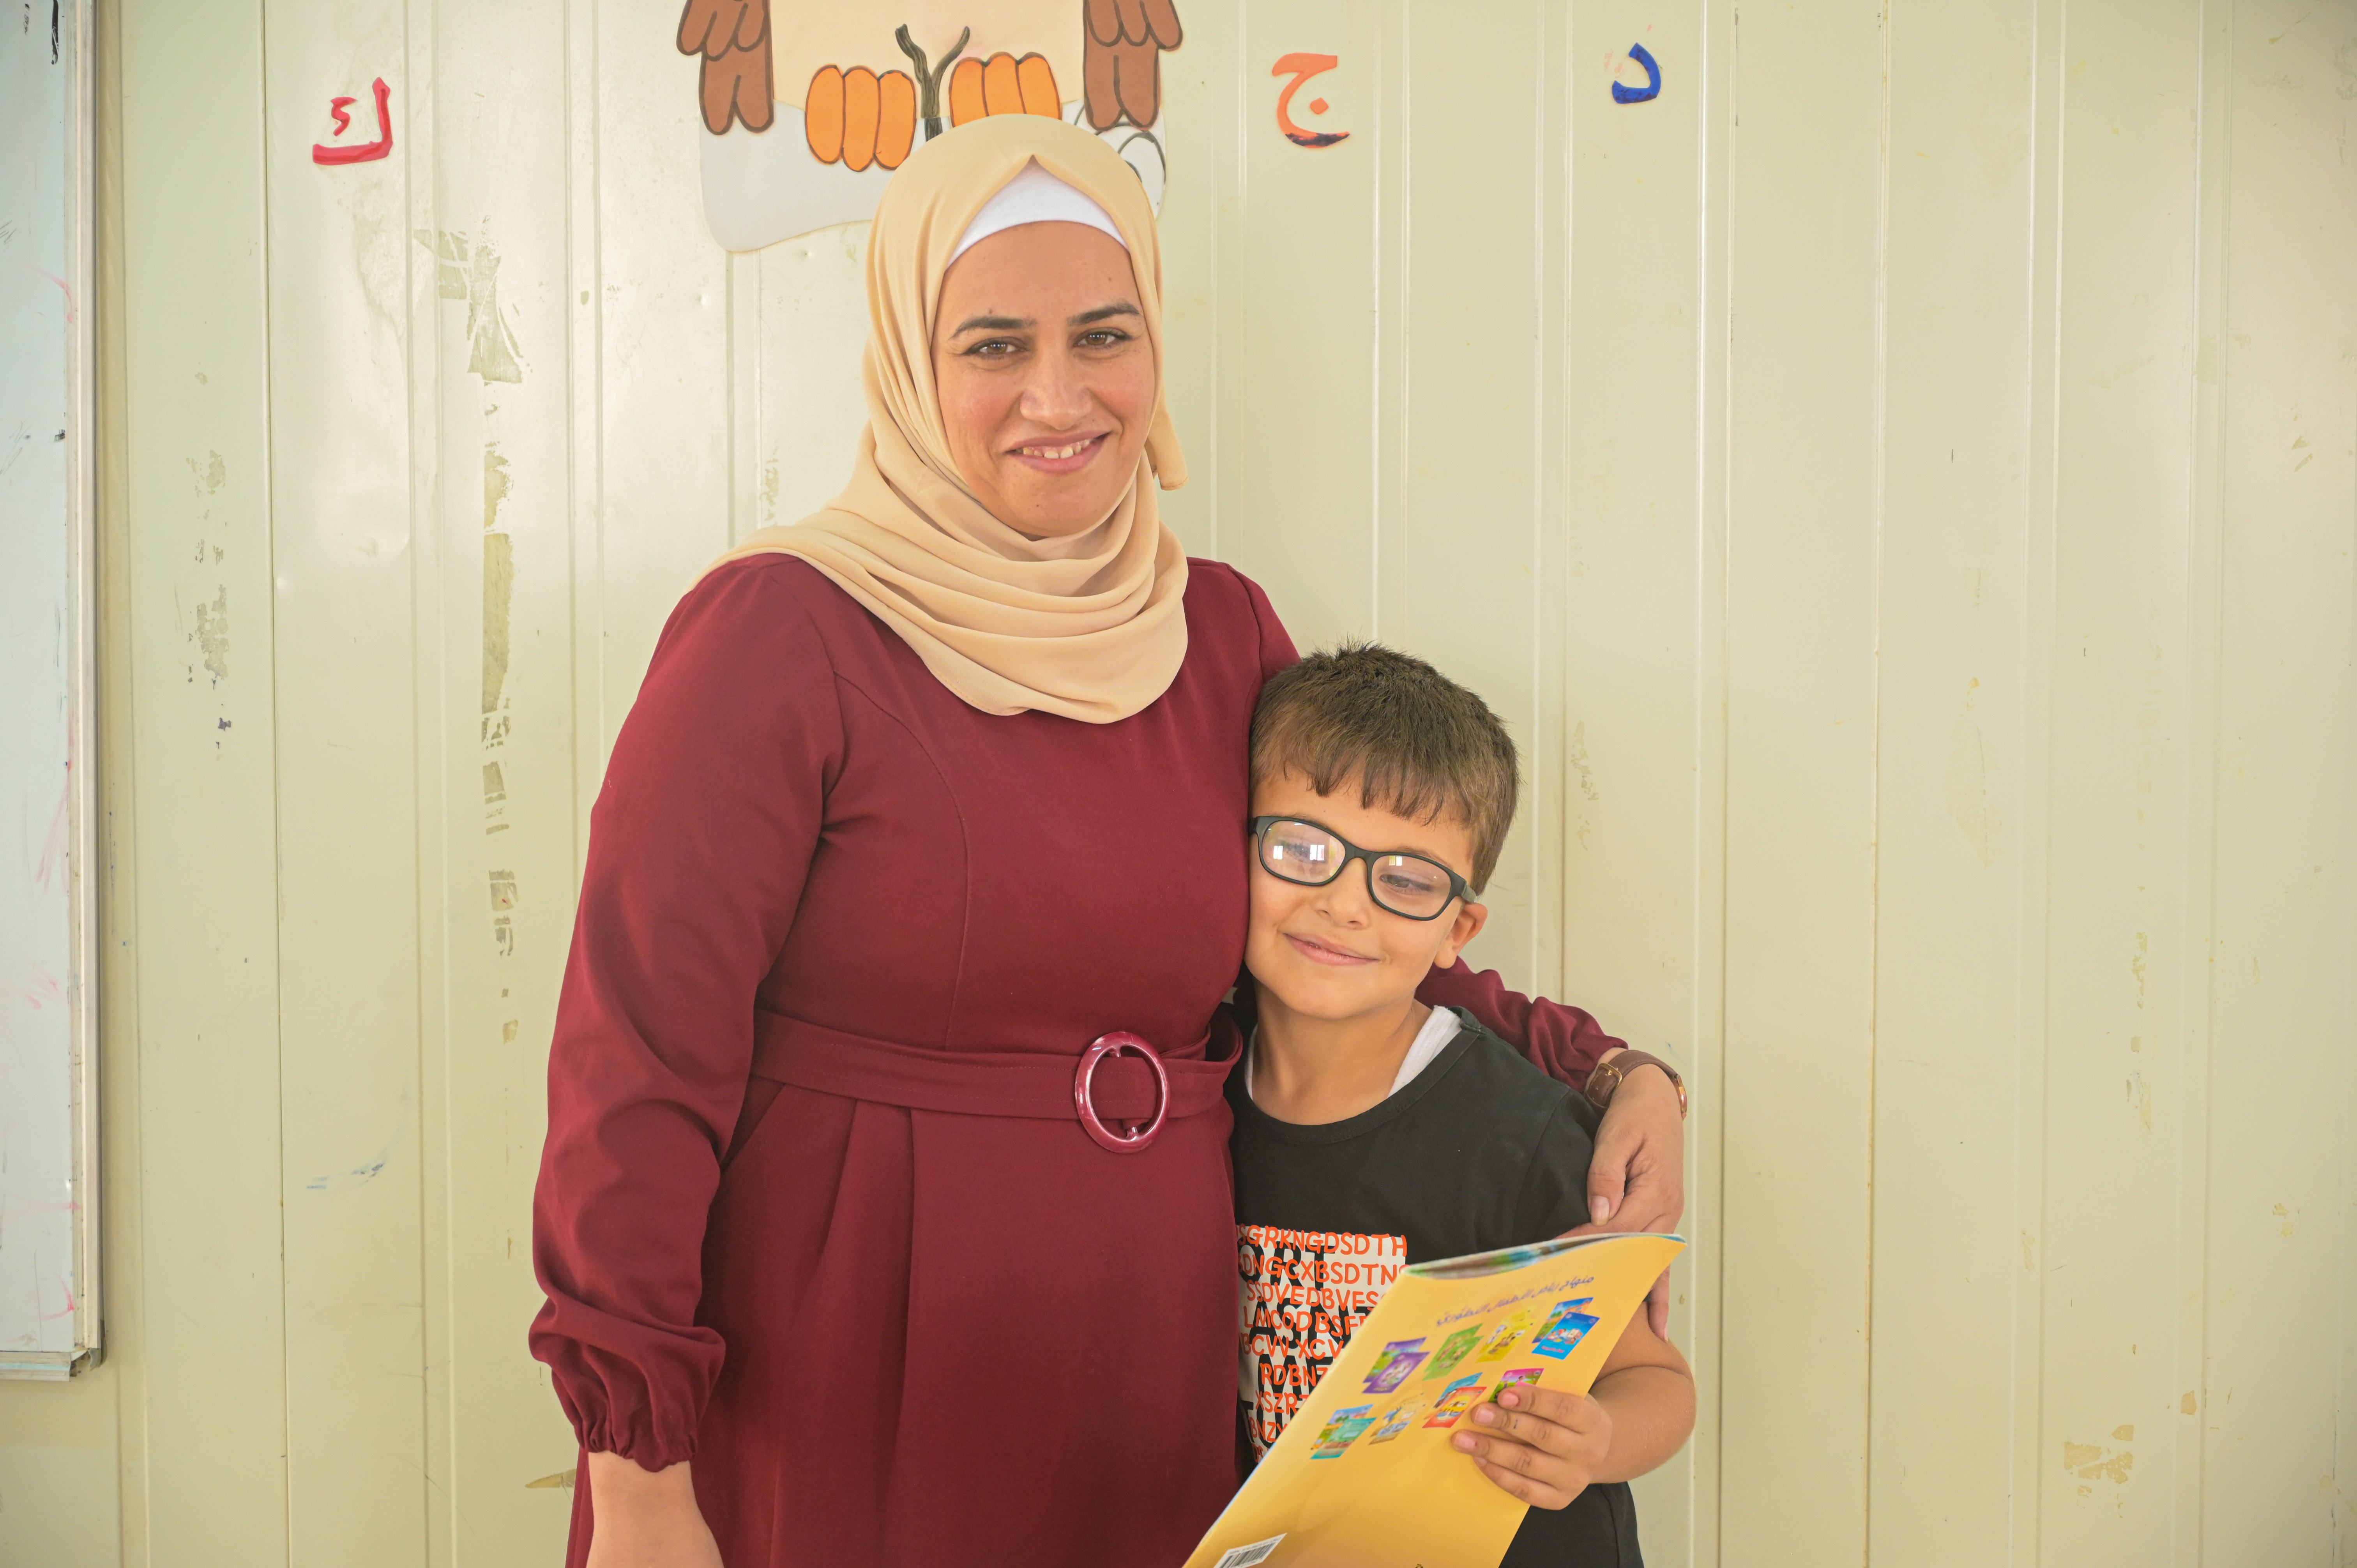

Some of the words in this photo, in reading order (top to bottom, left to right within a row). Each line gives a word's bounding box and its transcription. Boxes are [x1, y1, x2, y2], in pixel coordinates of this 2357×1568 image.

[1272, 52, 1350, 148] ج
[1612, 43, 1661, 104] د
[313, 77, 393, 166] ك
[1238, 1253, 1410, 1285] DNGCXBSDTN
[1247, 1279, 1387, 1311] SSDVEDBVFS
